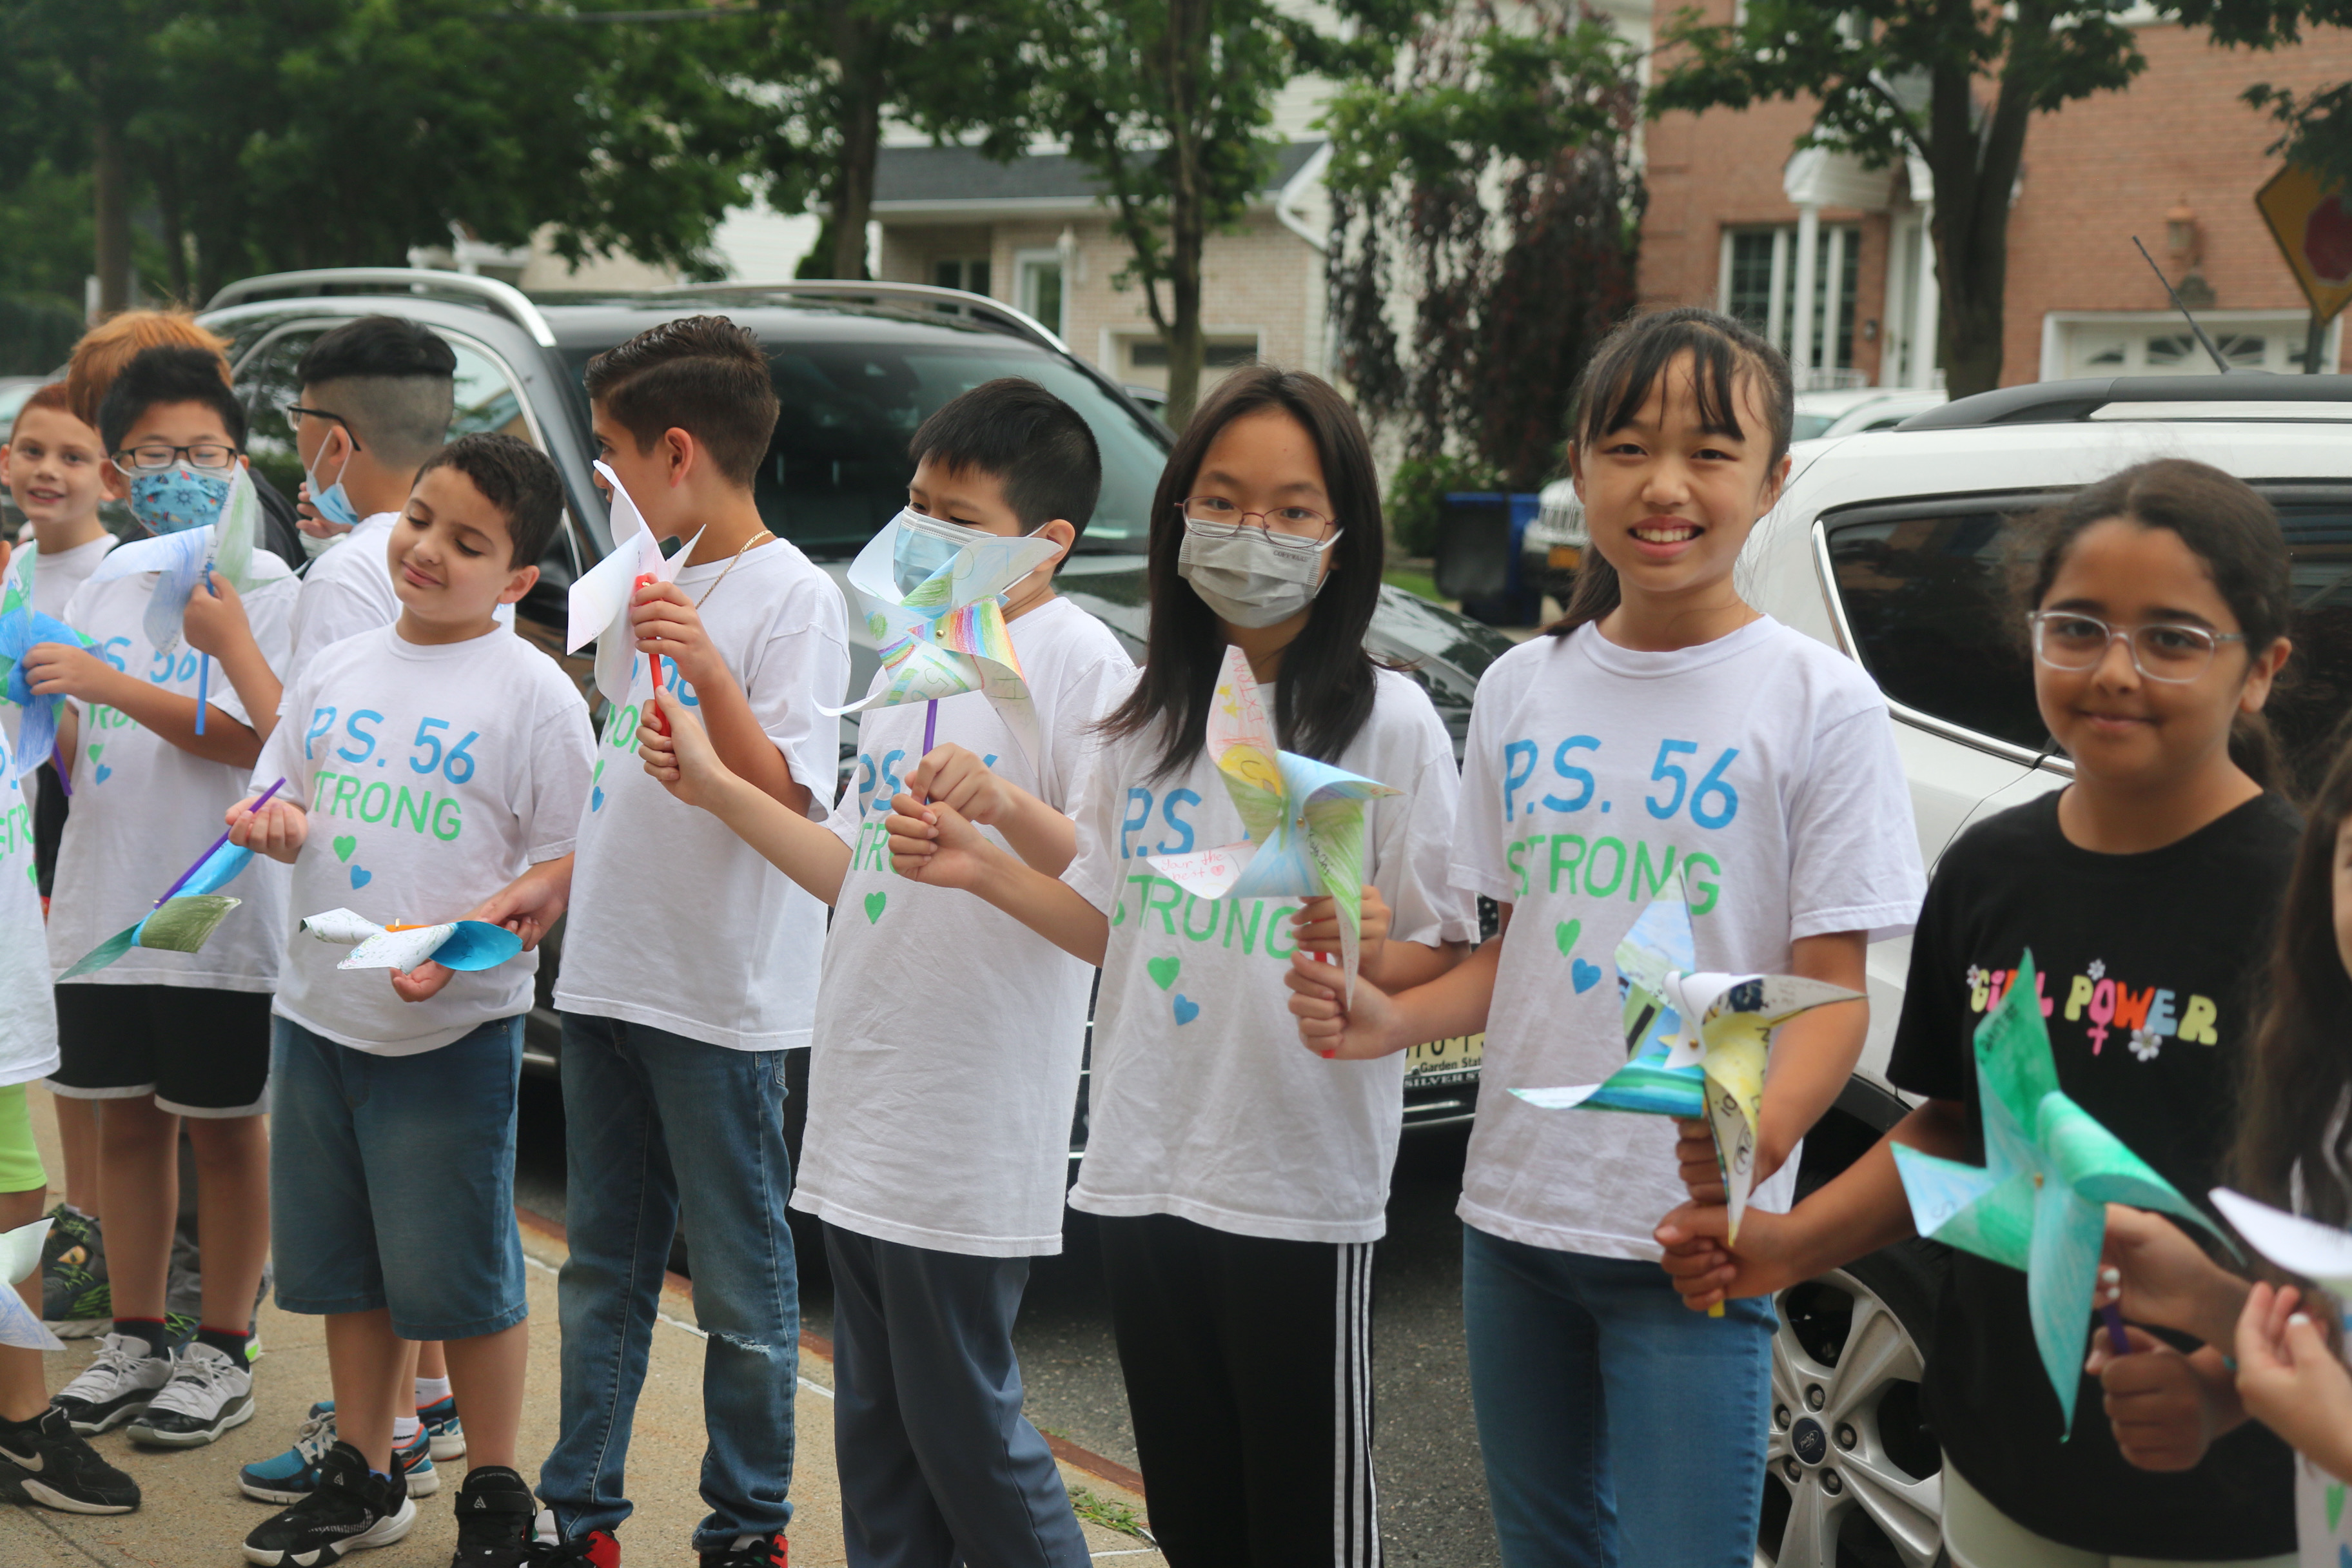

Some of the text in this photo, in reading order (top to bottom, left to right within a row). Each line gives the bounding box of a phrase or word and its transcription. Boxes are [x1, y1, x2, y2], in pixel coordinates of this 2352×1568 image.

[409, 716, 480, 785] 56
[1504, 735, 1740, 830] P.S. 56
[313, 770, 462, 841] TRONG
[1121, 787, 1202, 859] P.S
[1172, 867, 1206, 882] best
[1201, 850, 1223, 865] the
[2064, 974, 2219, 1051] POWER
[1404, 1072, 1464, 1088] SILVER
[1420, 1056, 1481, 1073] Garden Stat
